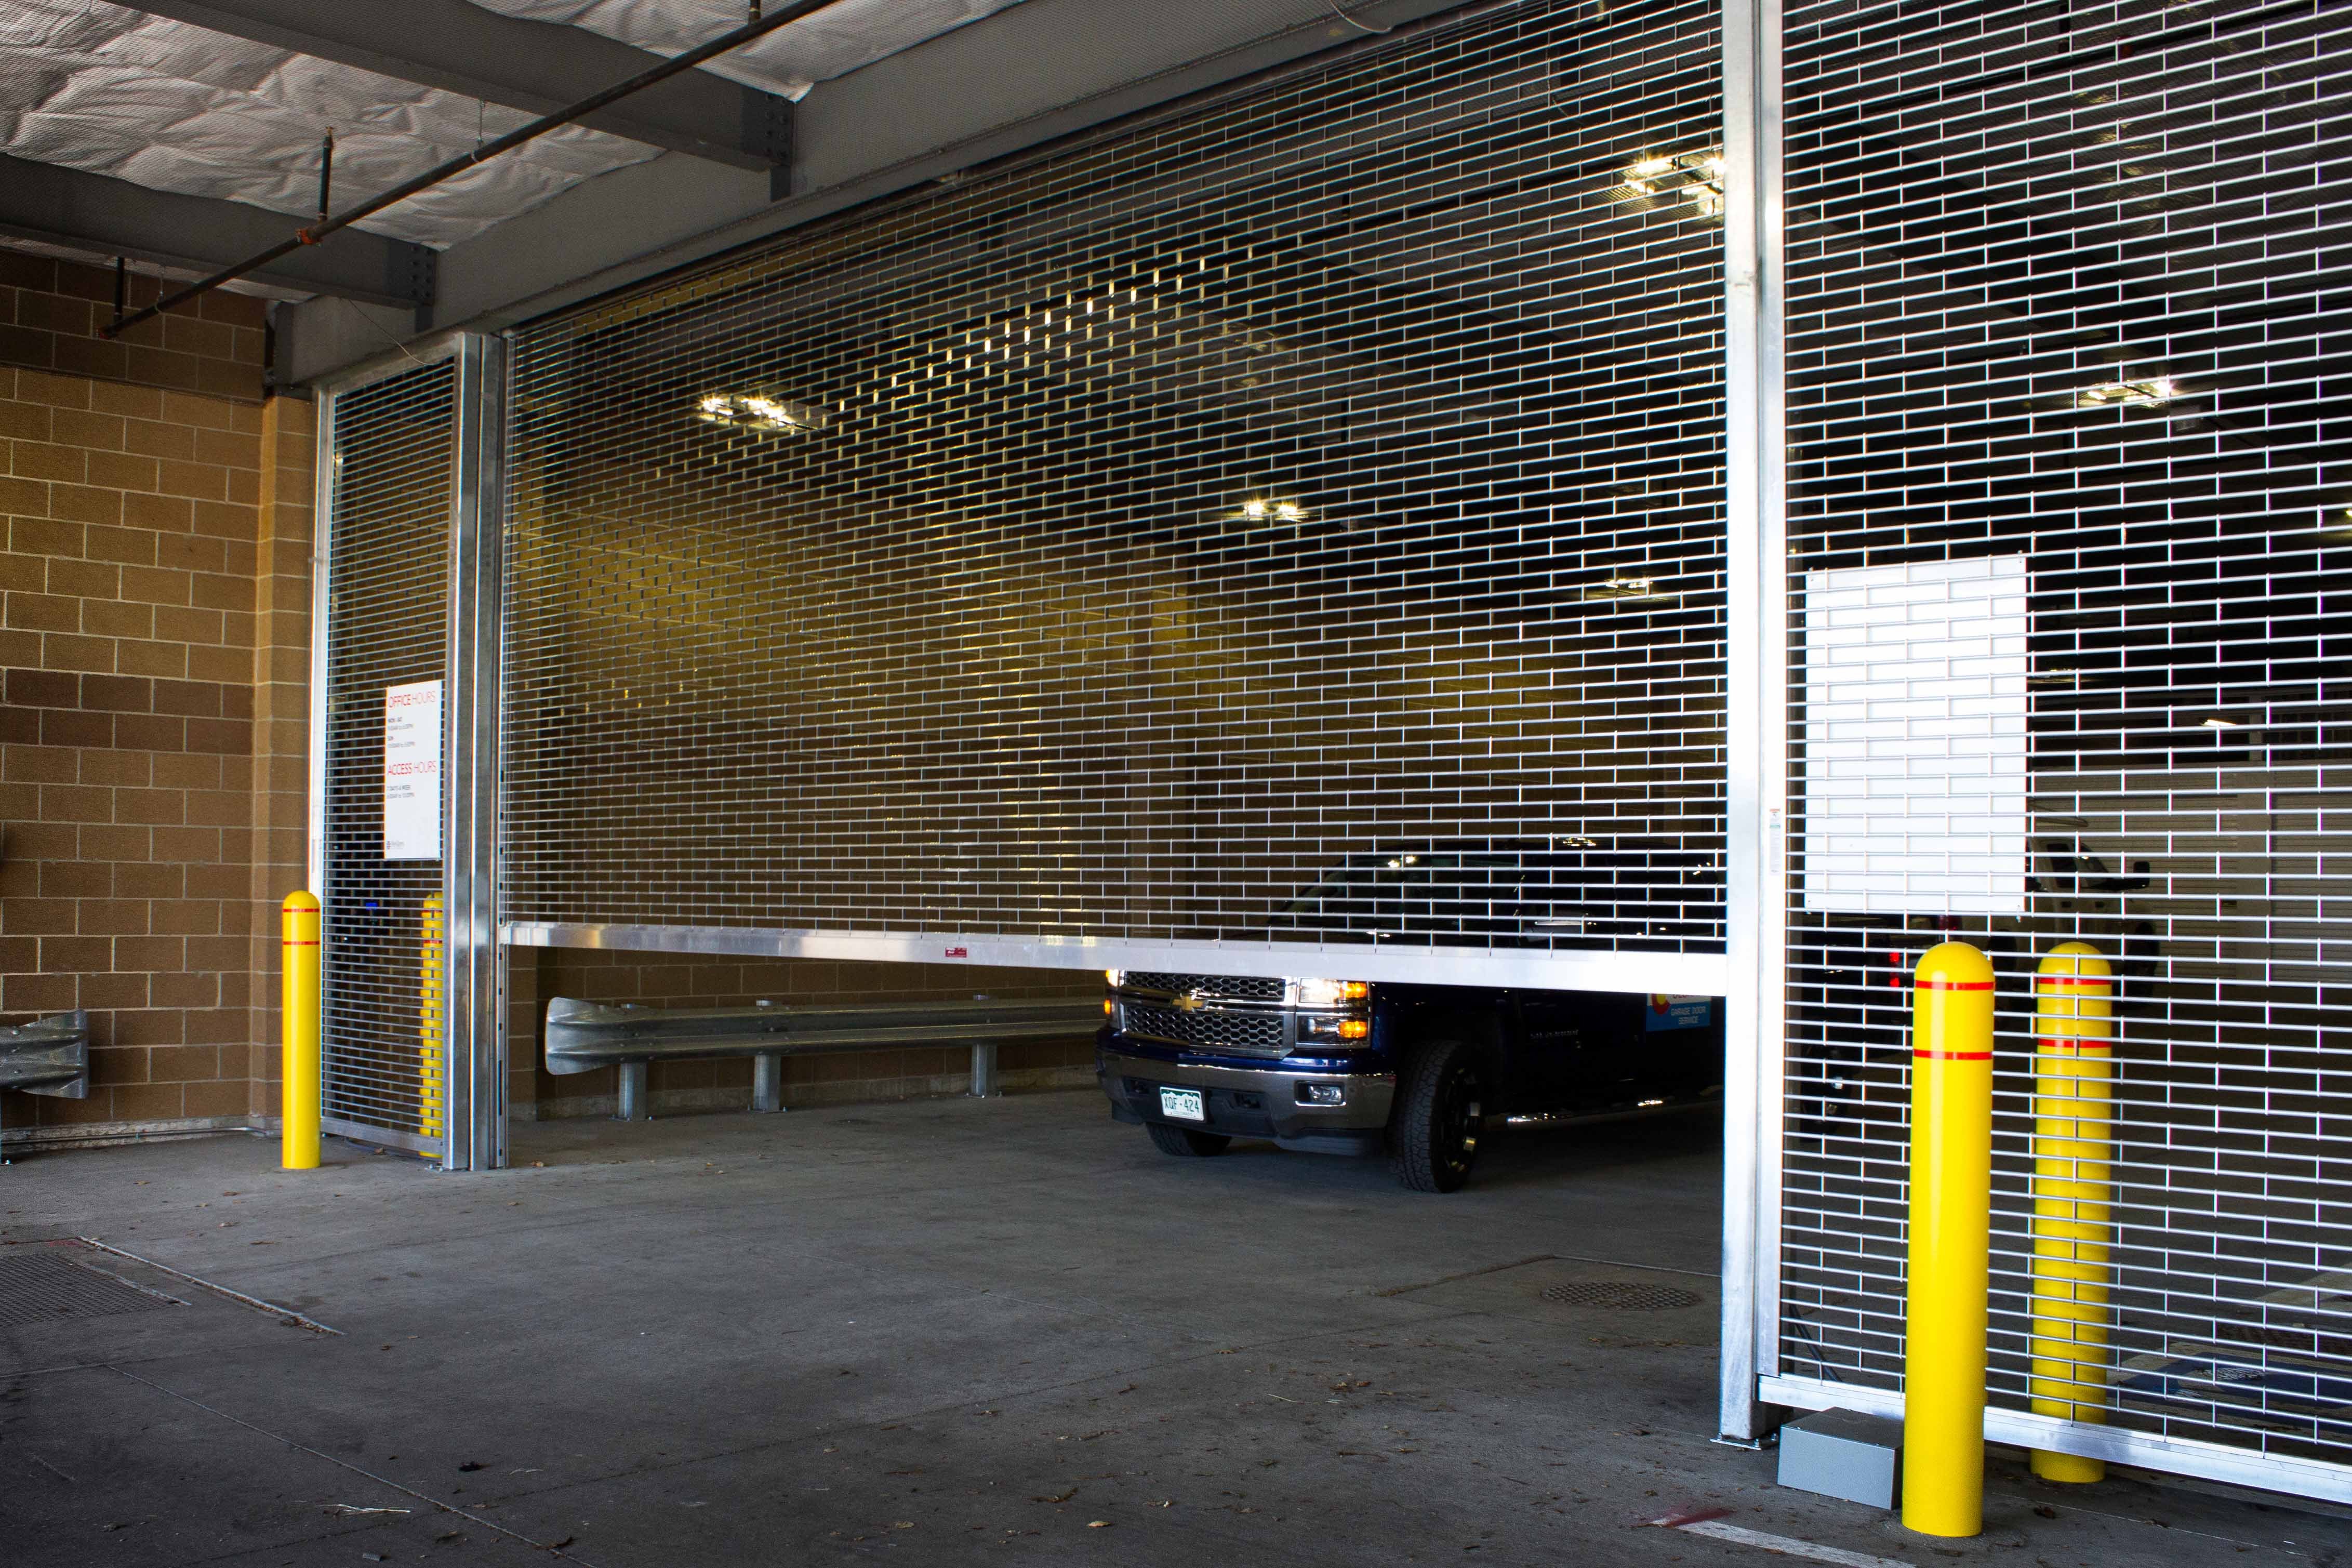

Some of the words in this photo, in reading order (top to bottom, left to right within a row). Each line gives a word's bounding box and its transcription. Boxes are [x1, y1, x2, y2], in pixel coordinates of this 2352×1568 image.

[388, 694, 412, 708] OFFICE
[412, 690, 436, 705] HOURS
[388, 762, 412, 775] ACCESS
[414, 760, 437, 774] HOURS
[1691, 1006, 1706, 1014] DOOR
